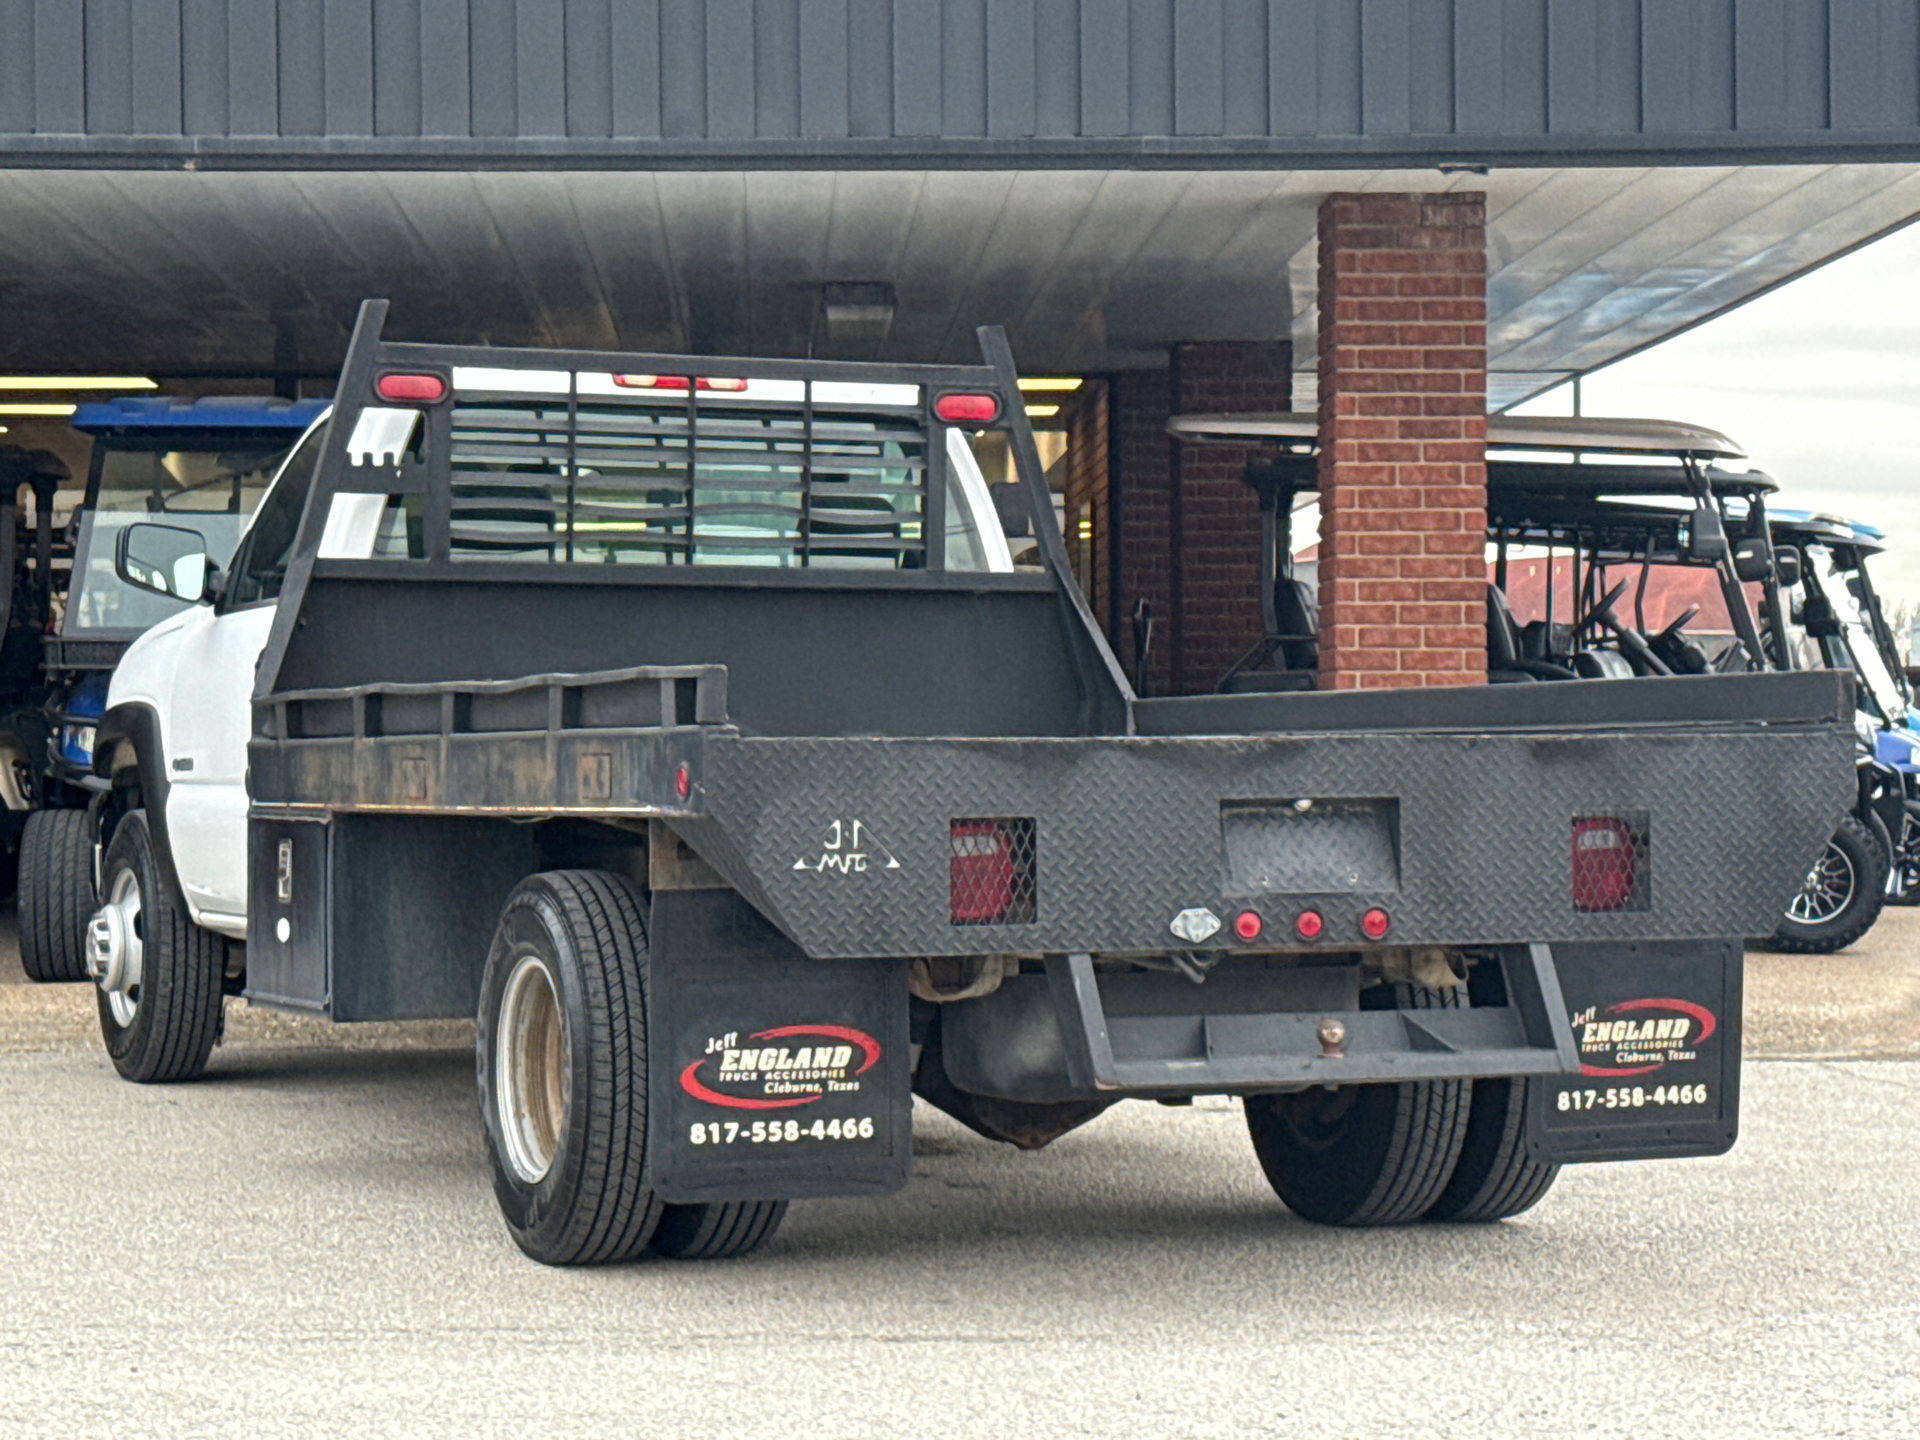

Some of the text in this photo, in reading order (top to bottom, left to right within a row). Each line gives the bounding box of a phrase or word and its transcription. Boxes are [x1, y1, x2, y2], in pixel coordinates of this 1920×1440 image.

[1572, 1006, 1597, 1028] Jeff
[1582, 1018, 1691, 1043] ENGLAND
[705, 1031, 739, 1055] Jeff
[1581, 1040, 1685, 1053] TRUCK ACCESSORIES
[720, 1046, 853, 1072] ENGLAND
[1615, 1049, 1697, 1064] Cleburne, Texas
[719, 1069, 846, 1083] TRUCK ACCESSORIES
[764, 1080, 861, 1094] Cleburne, Texas
[1557, 1083, 1708, 1112] 817-558-4466
[690, 1117, 875, 1145] 817-558-4466
